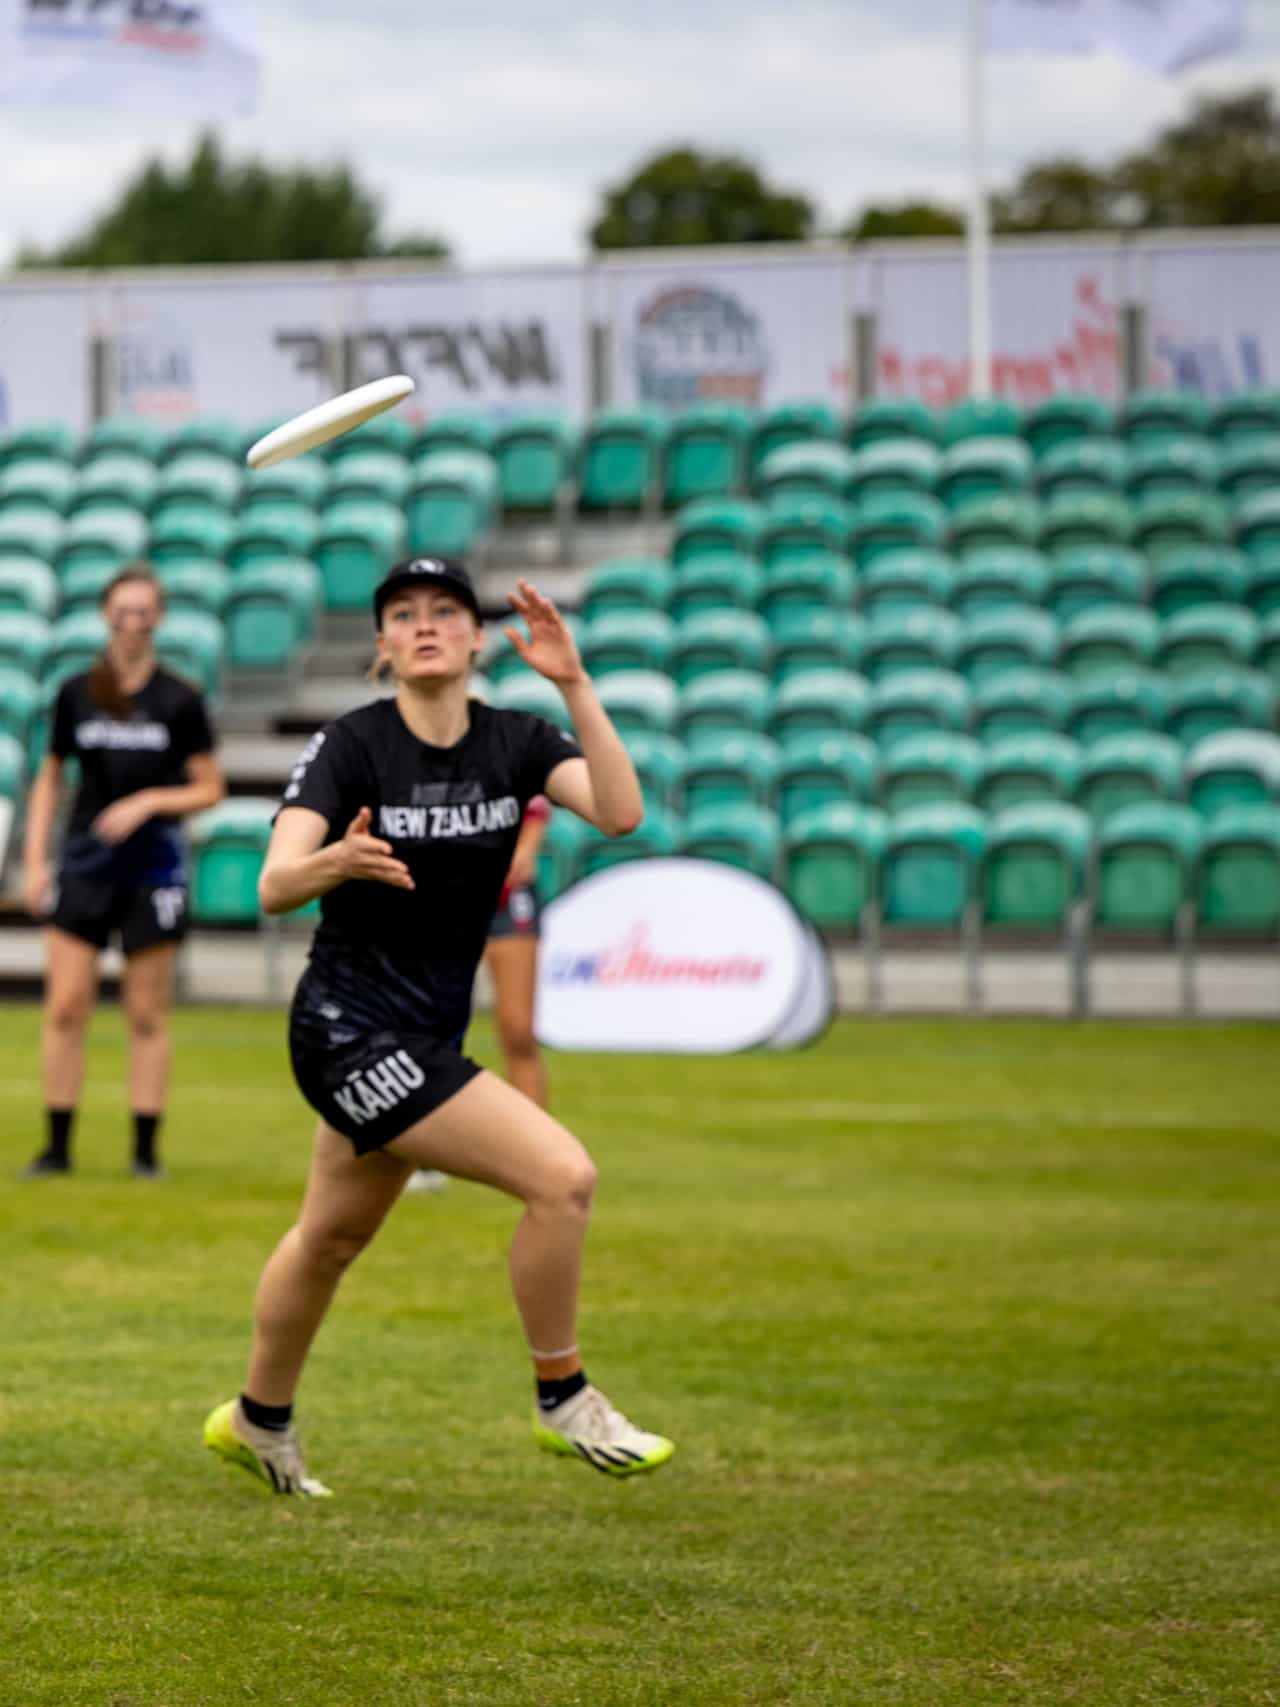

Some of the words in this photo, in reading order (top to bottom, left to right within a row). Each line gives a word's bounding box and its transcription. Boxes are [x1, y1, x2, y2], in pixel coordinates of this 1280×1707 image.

[379, 805, 427, 838] NEW
[429, 796, 520, 838] ZEALAND
[332, 1049, 426, 1126] KĀHU
